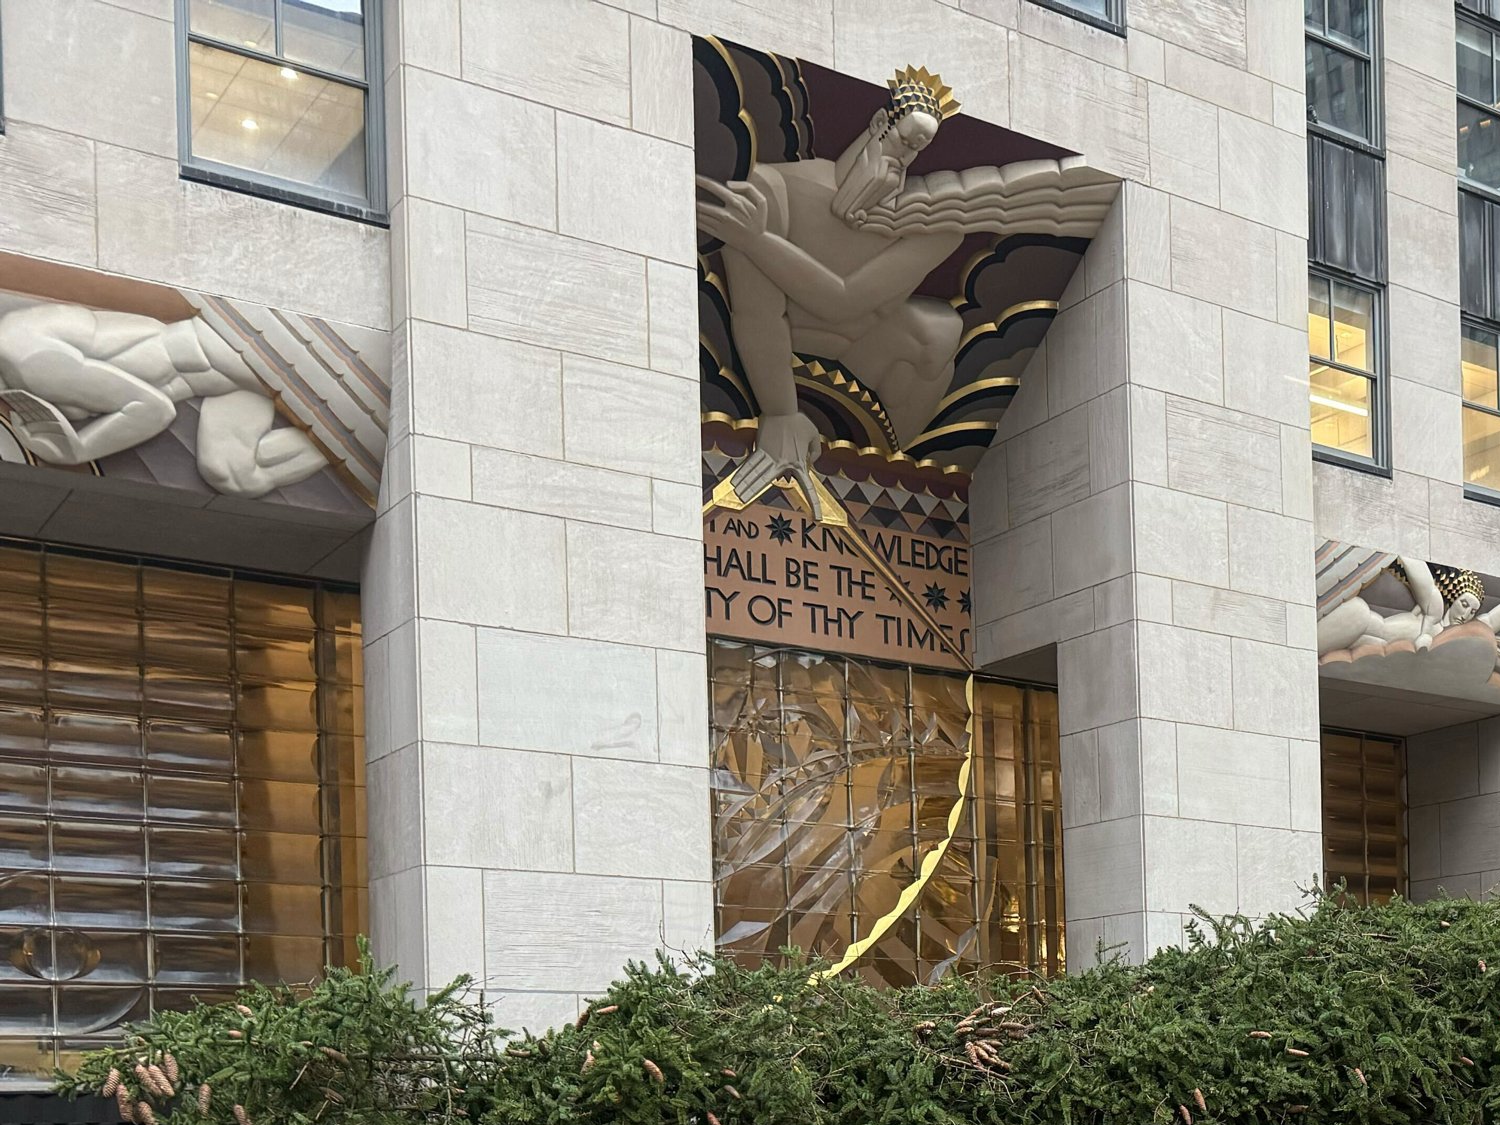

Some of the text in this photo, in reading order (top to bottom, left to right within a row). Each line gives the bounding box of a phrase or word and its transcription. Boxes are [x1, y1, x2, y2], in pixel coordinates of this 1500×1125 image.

[723, 517, 760, 539] AND
[785, 557, 819, 592] BE
[829, 564, 875, 601] THE
[747, 594, 792, 629] OF
[802, 601, 864, 640] THY
